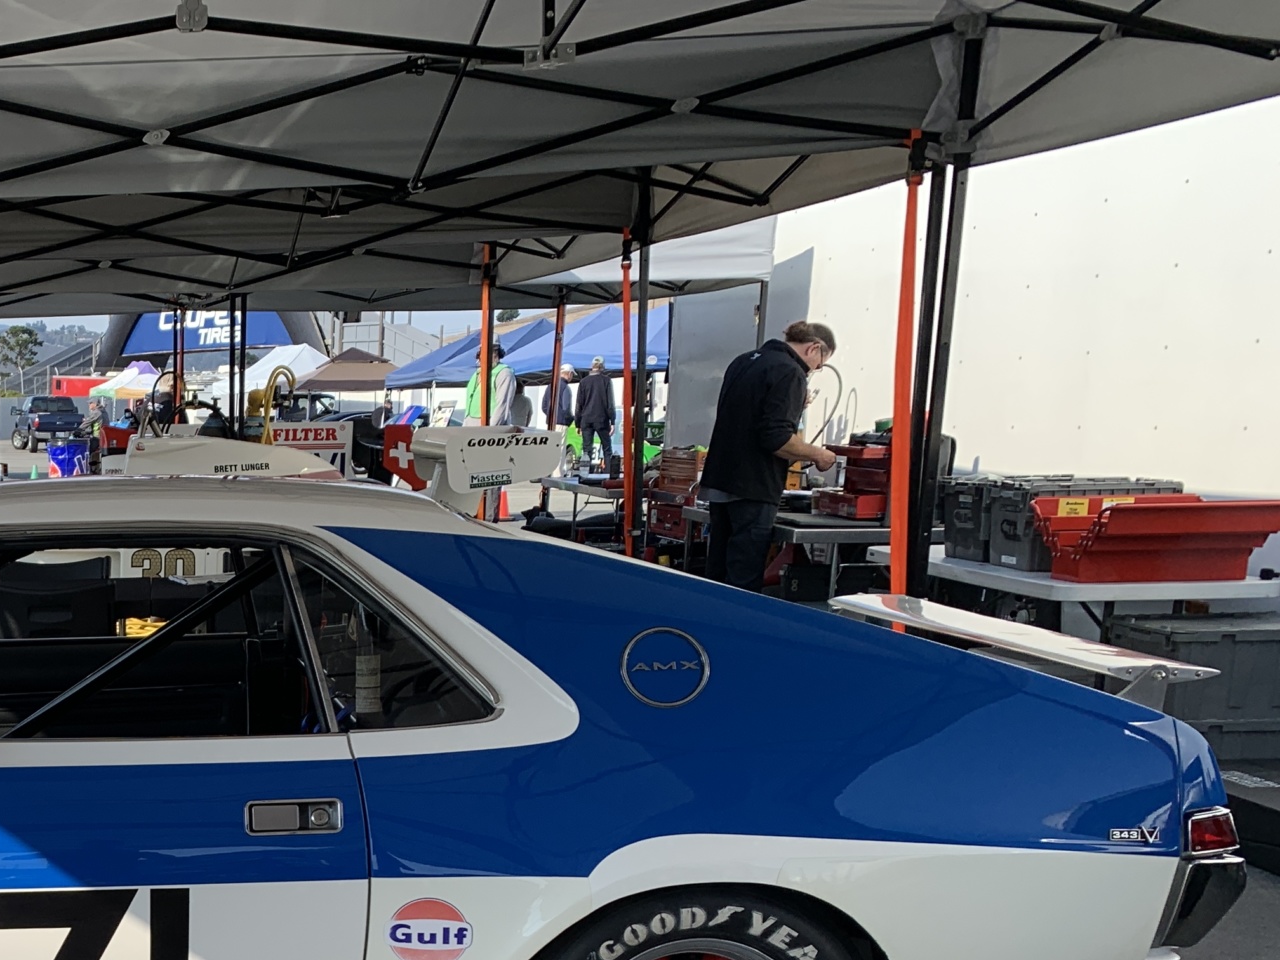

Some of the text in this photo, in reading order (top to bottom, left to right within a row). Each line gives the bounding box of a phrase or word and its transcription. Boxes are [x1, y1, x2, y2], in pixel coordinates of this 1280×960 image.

[159, 310, 242, 330] COPE
[198, 324, 242, 345] TIRES
[273, 427, 337, 442] FILTER
[214, 462, 270, 473] BRETT LUNGER
[470, 473, 511, 484] Masters
[631, 660, 700, 672] AMX
[1112, 831, 1138, 840] 343
[389, 923, 468, 946] Gulf
